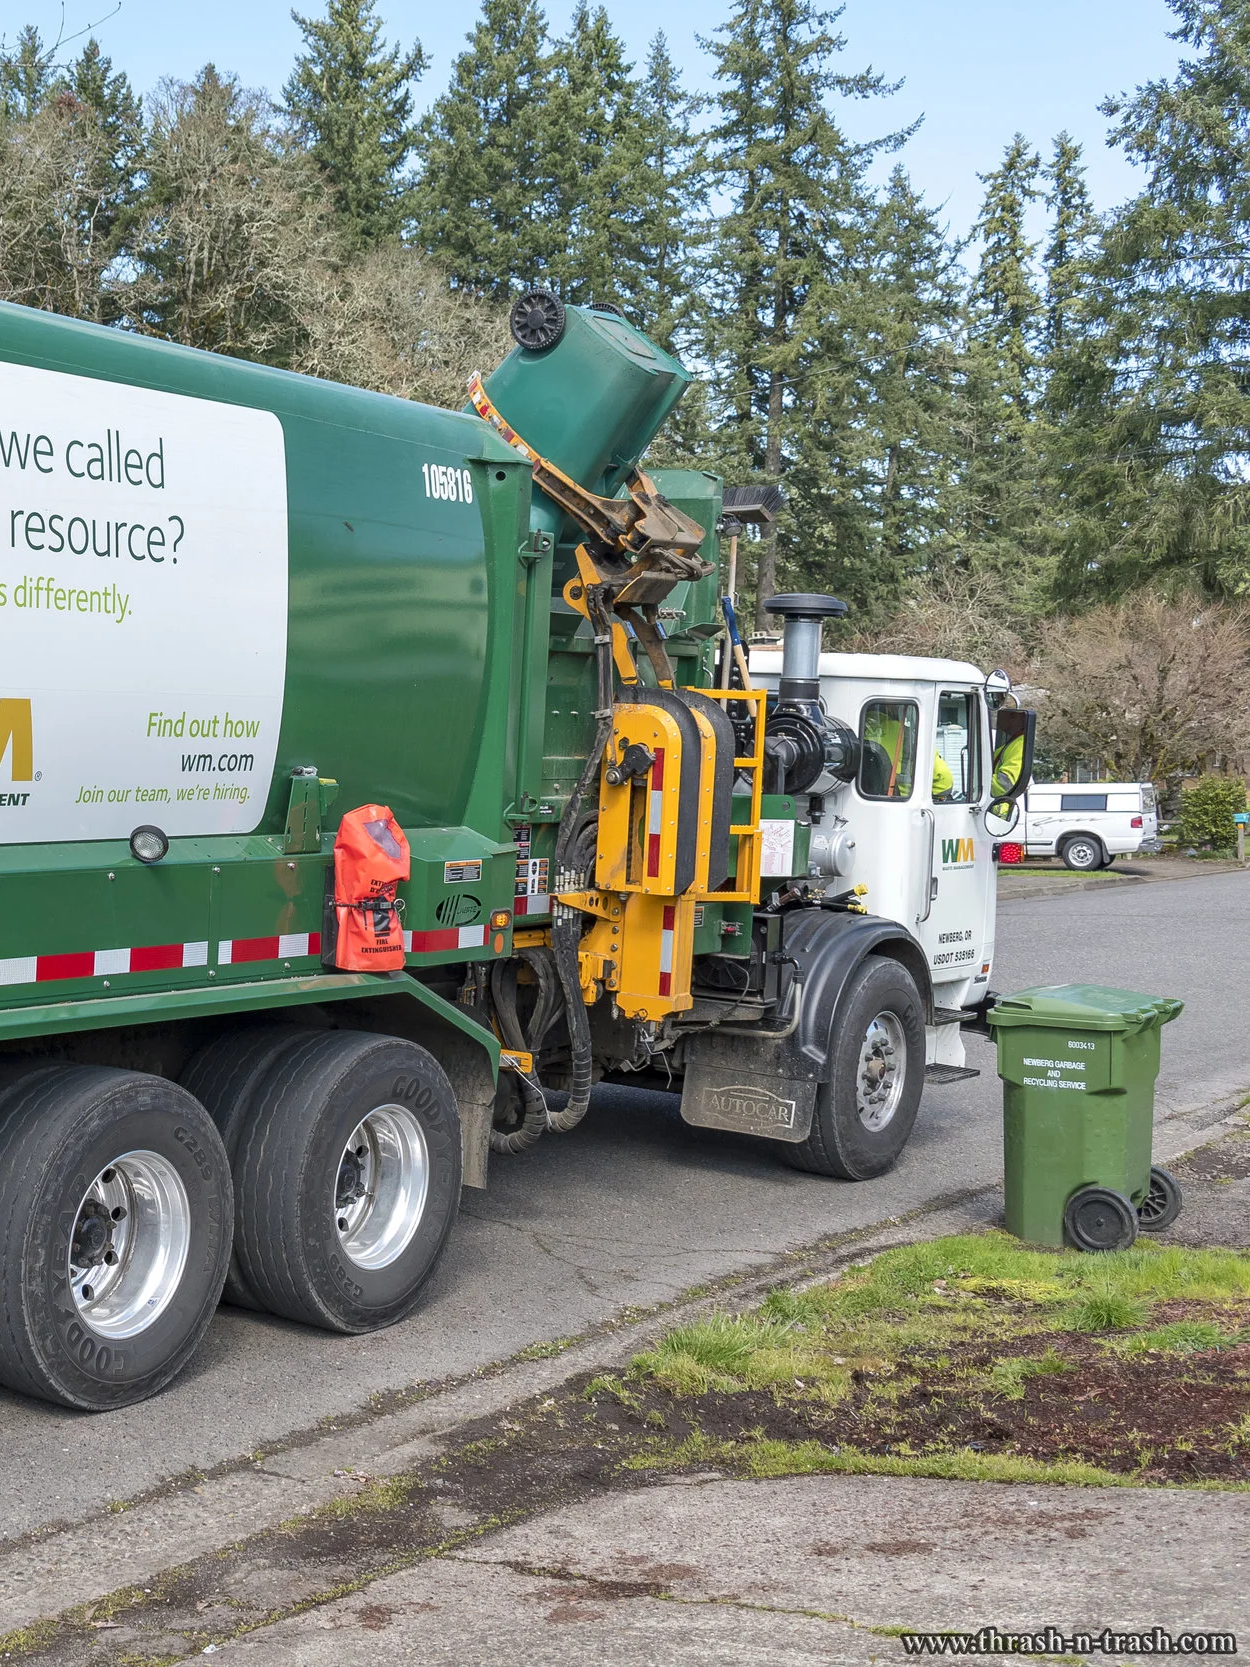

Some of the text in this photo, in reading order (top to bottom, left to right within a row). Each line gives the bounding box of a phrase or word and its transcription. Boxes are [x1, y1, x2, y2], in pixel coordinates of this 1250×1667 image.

[65, 428, 166, 490] called
[421, 463, 474, 504] 105816
[10, 507, 186, 565] resource?
[14, 576, 133, 623] differently.
[146, 711, 260, 738] Find out how
[181, 753, 254, 772] wm.com
[75, 785, 104, 804] Join
[107, 788, 132, 803] our
[135, 786, 172, 804] team,
[213, 783, 250, 804] hiring.
[941, 837, 975, 863] WM
[965, 930, 972, 940] OR
[933, 952, 954, 965] USDOT
[1067, 1041, 1095, 1050] 6003413
[1023, 1058, 1086, 1070] NEWBERG GARBAGE
[1047, 1069, 1061, 1078] AND
[1023, 1077, 1086, 1090] RECYCLING SERVICE
[710, 1094, 789, 1122] AUTOCAR
[174, 1126, 214, 1181] G289
